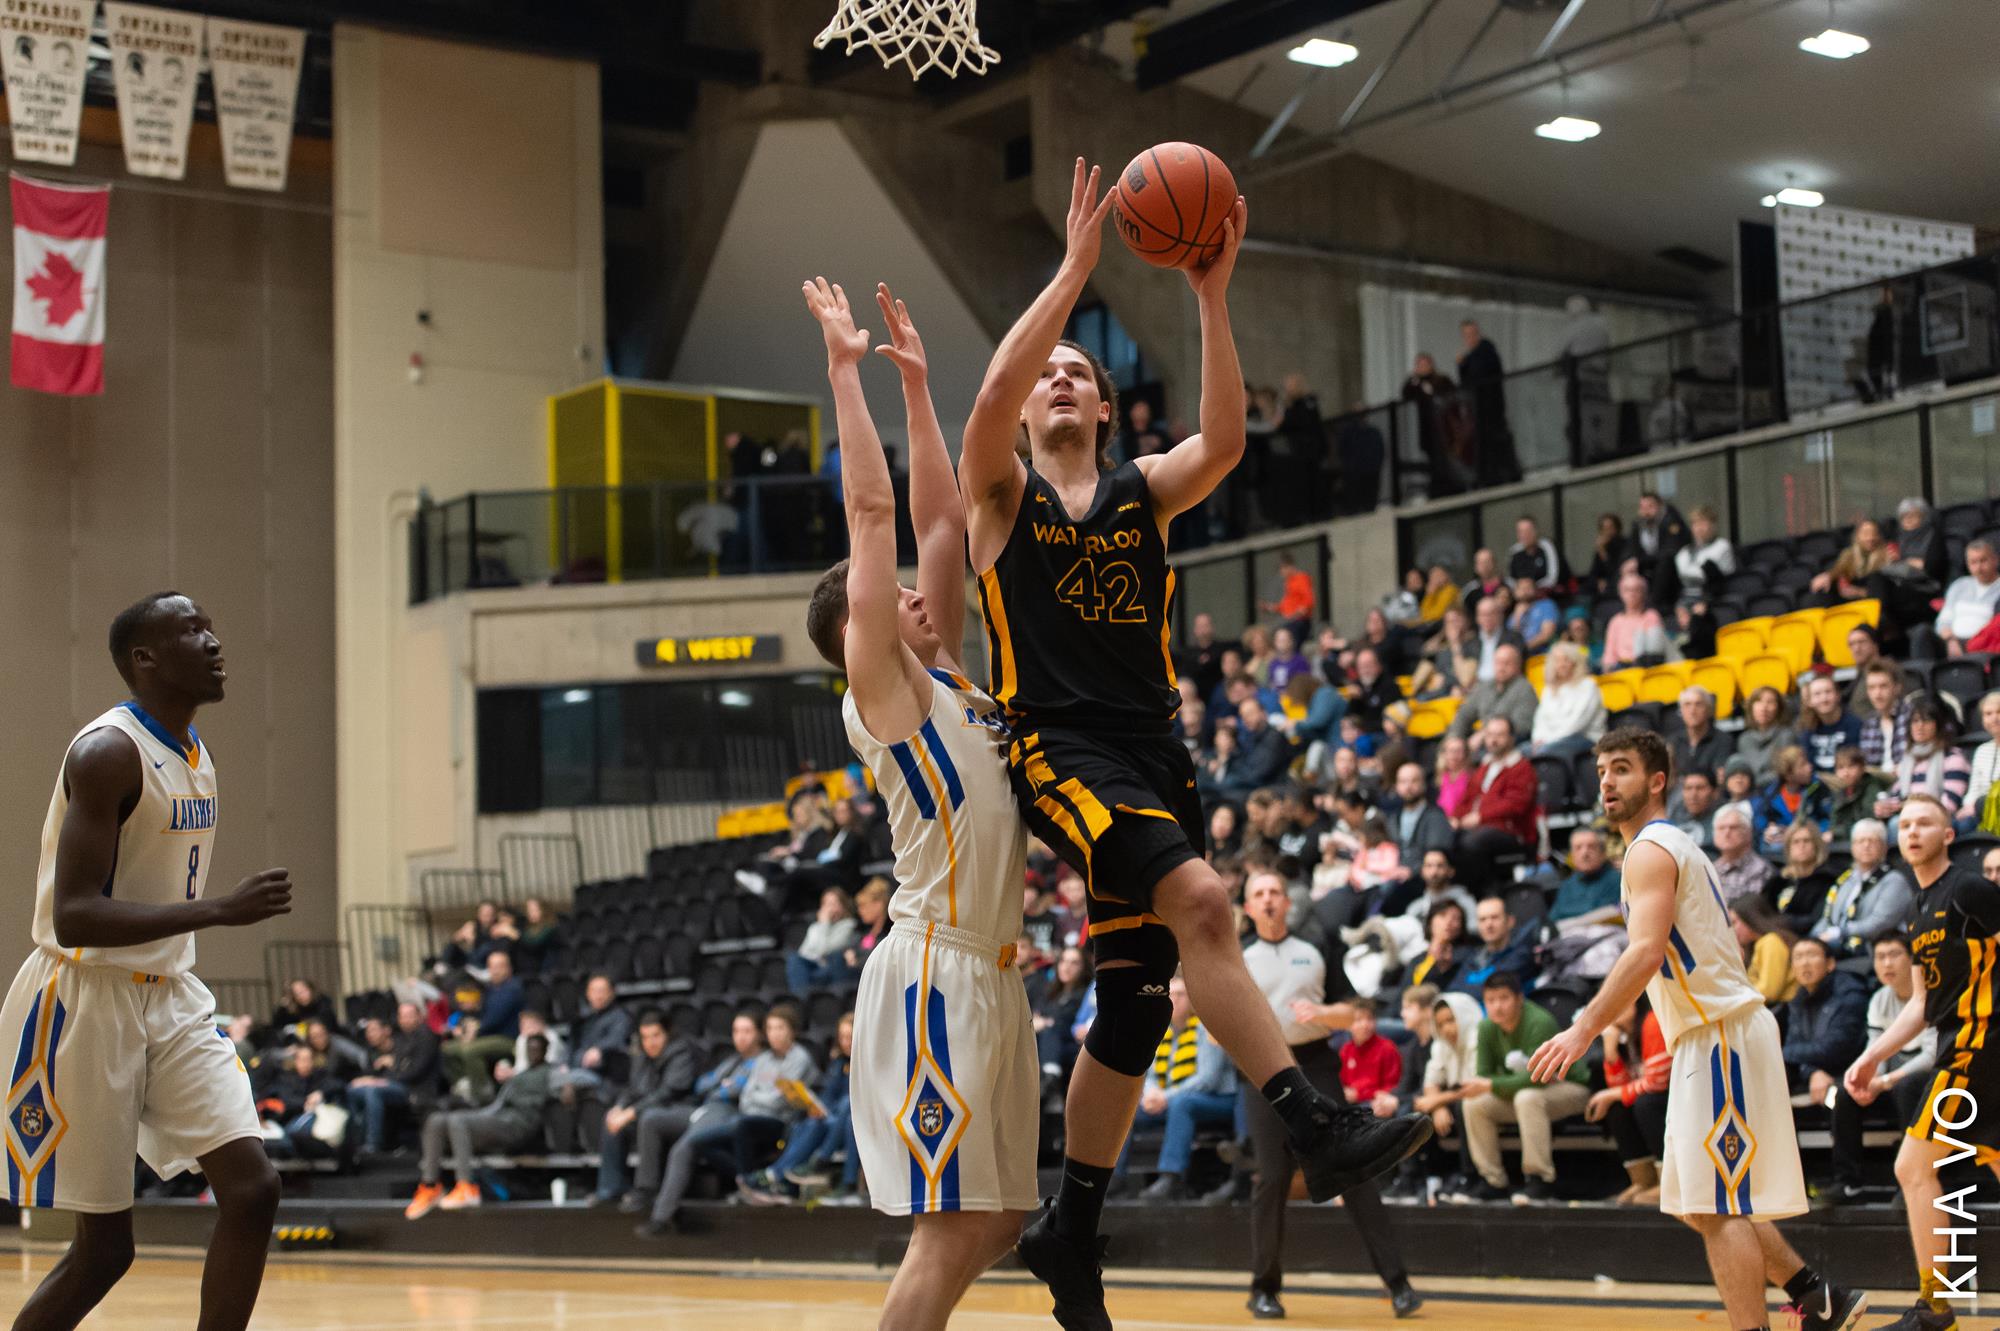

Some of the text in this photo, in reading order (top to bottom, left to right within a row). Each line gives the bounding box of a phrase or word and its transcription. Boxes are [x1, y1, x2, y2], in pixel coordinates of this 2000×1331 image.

[0, 15, 86, 40] CHAMPIONS
[119, 15, 192, 36] ONTARIO
[113, 32, 196, 55] CHAMPIONS
[222, 31, 289, 50] ONTARIO
[215, 47, 295, 71] CHAMPIONS
[1033, 521, 1142, 556] WATRLOO
[1055, 557, 1148, 623] 42
[687, 635, 756, 661] WEST
[186, 844, 200, 900] 8
